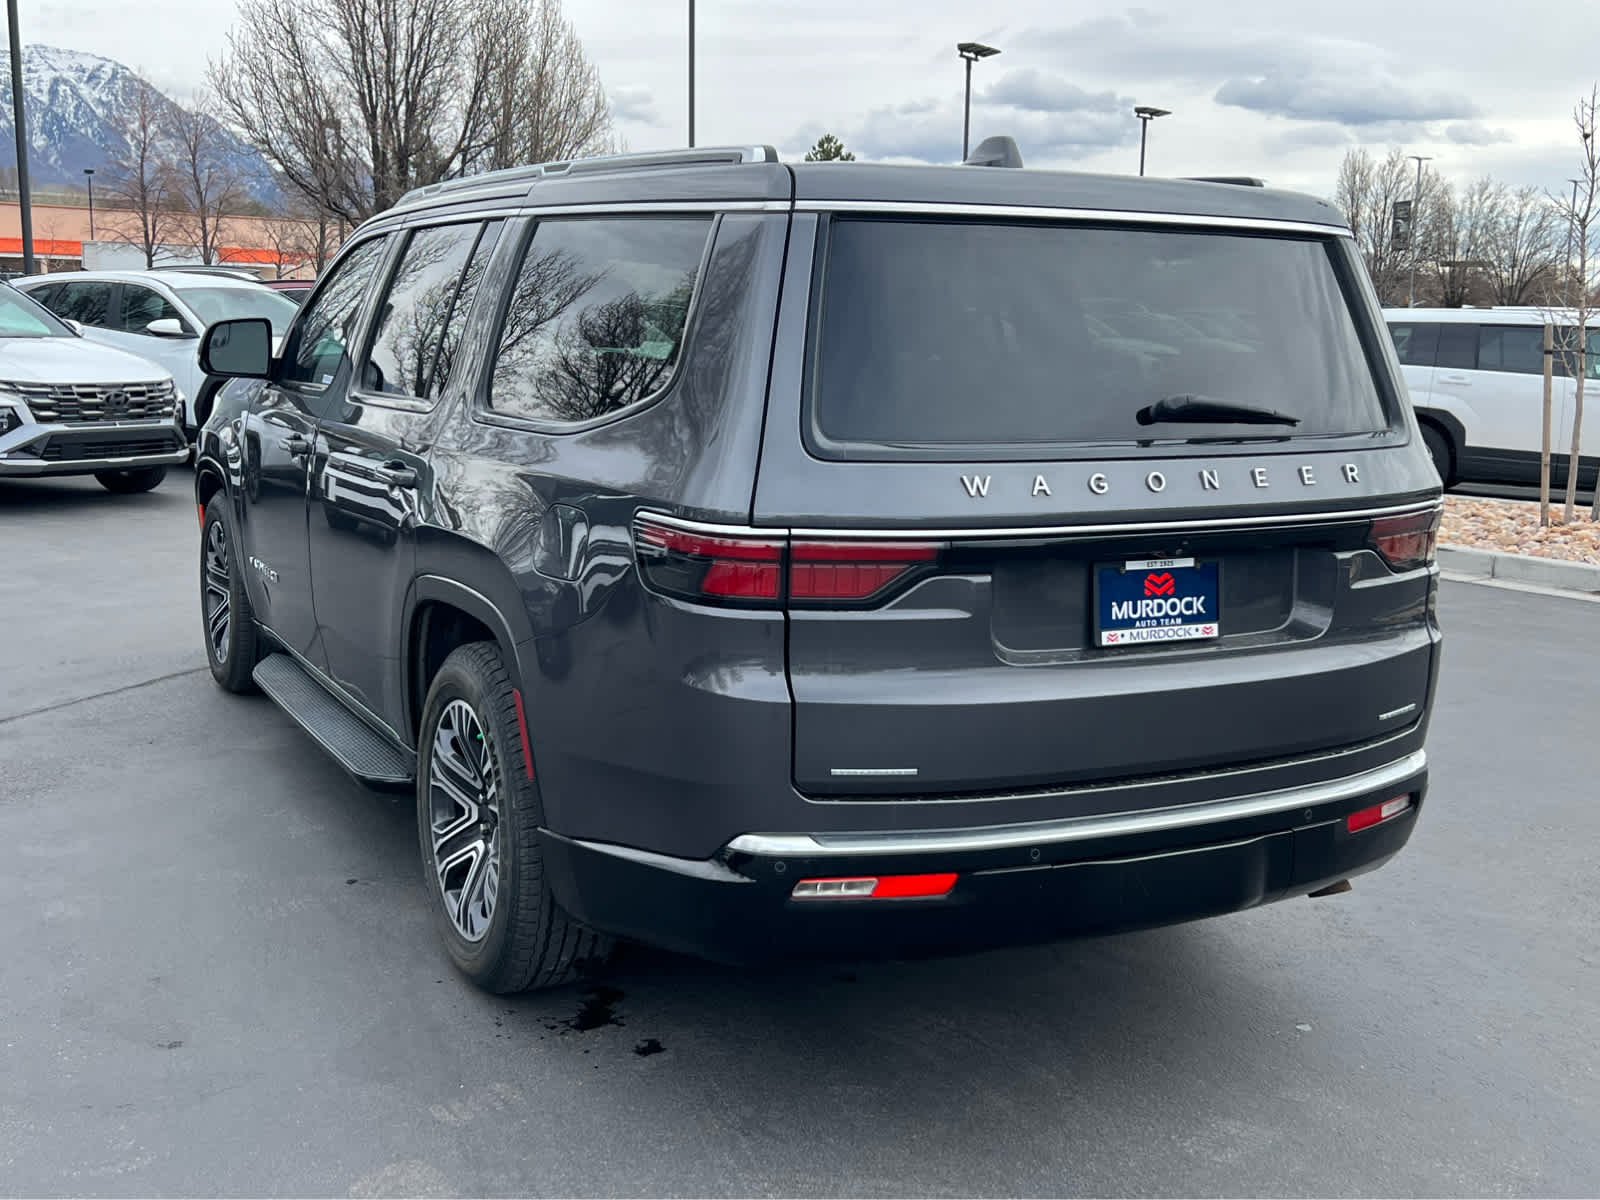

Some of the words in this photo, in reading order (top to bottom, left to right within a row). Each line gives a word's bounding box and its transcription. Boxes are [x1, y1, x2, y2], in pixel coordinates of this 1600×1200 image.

[961, 464, 1360, 497] WAGONEER
[1111, 596, 1206, 620] MURDOCK
[1135, 619, 1157, 628] AUTO
[1160, 618, 1182, 626] TEAM
[1129, 627, 1192, 641] MURDOCK
